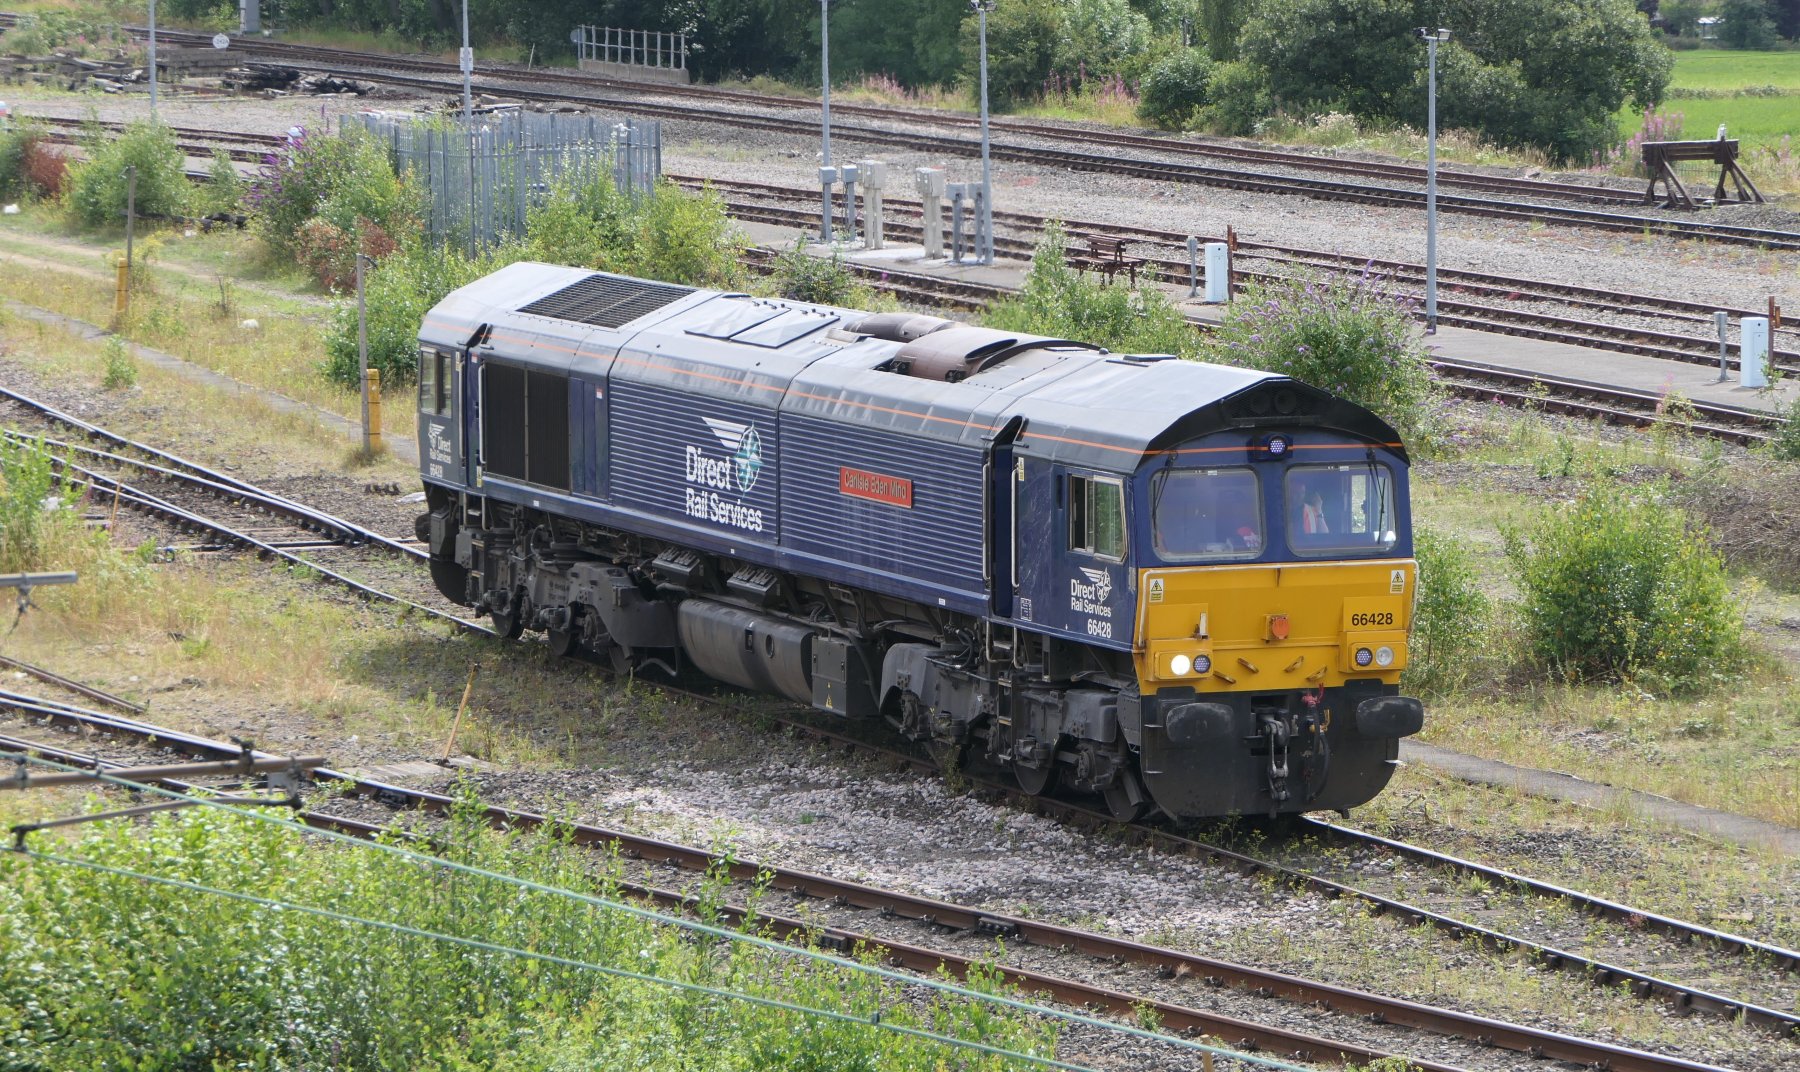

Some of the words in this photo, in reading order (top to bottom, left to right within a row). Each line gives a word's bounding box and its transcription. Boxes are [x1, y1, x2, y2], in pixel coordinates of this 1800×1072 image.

[437, 436, 451, 453] Direct
[686, 445, 731, 490] Direct
[871, 476, 888, 495] Eden
[686, 487, 708, 519] Rail
[710, 492, 763, 532] Services
[1071, 579, 1095, 600] Direct
[1071, 597, 1083, 612] Rail
[1083, 599, 1112, 618] Services
[1087, 618, 1112, 639] 66428
[1351, 612, 1393, 626] 66428
